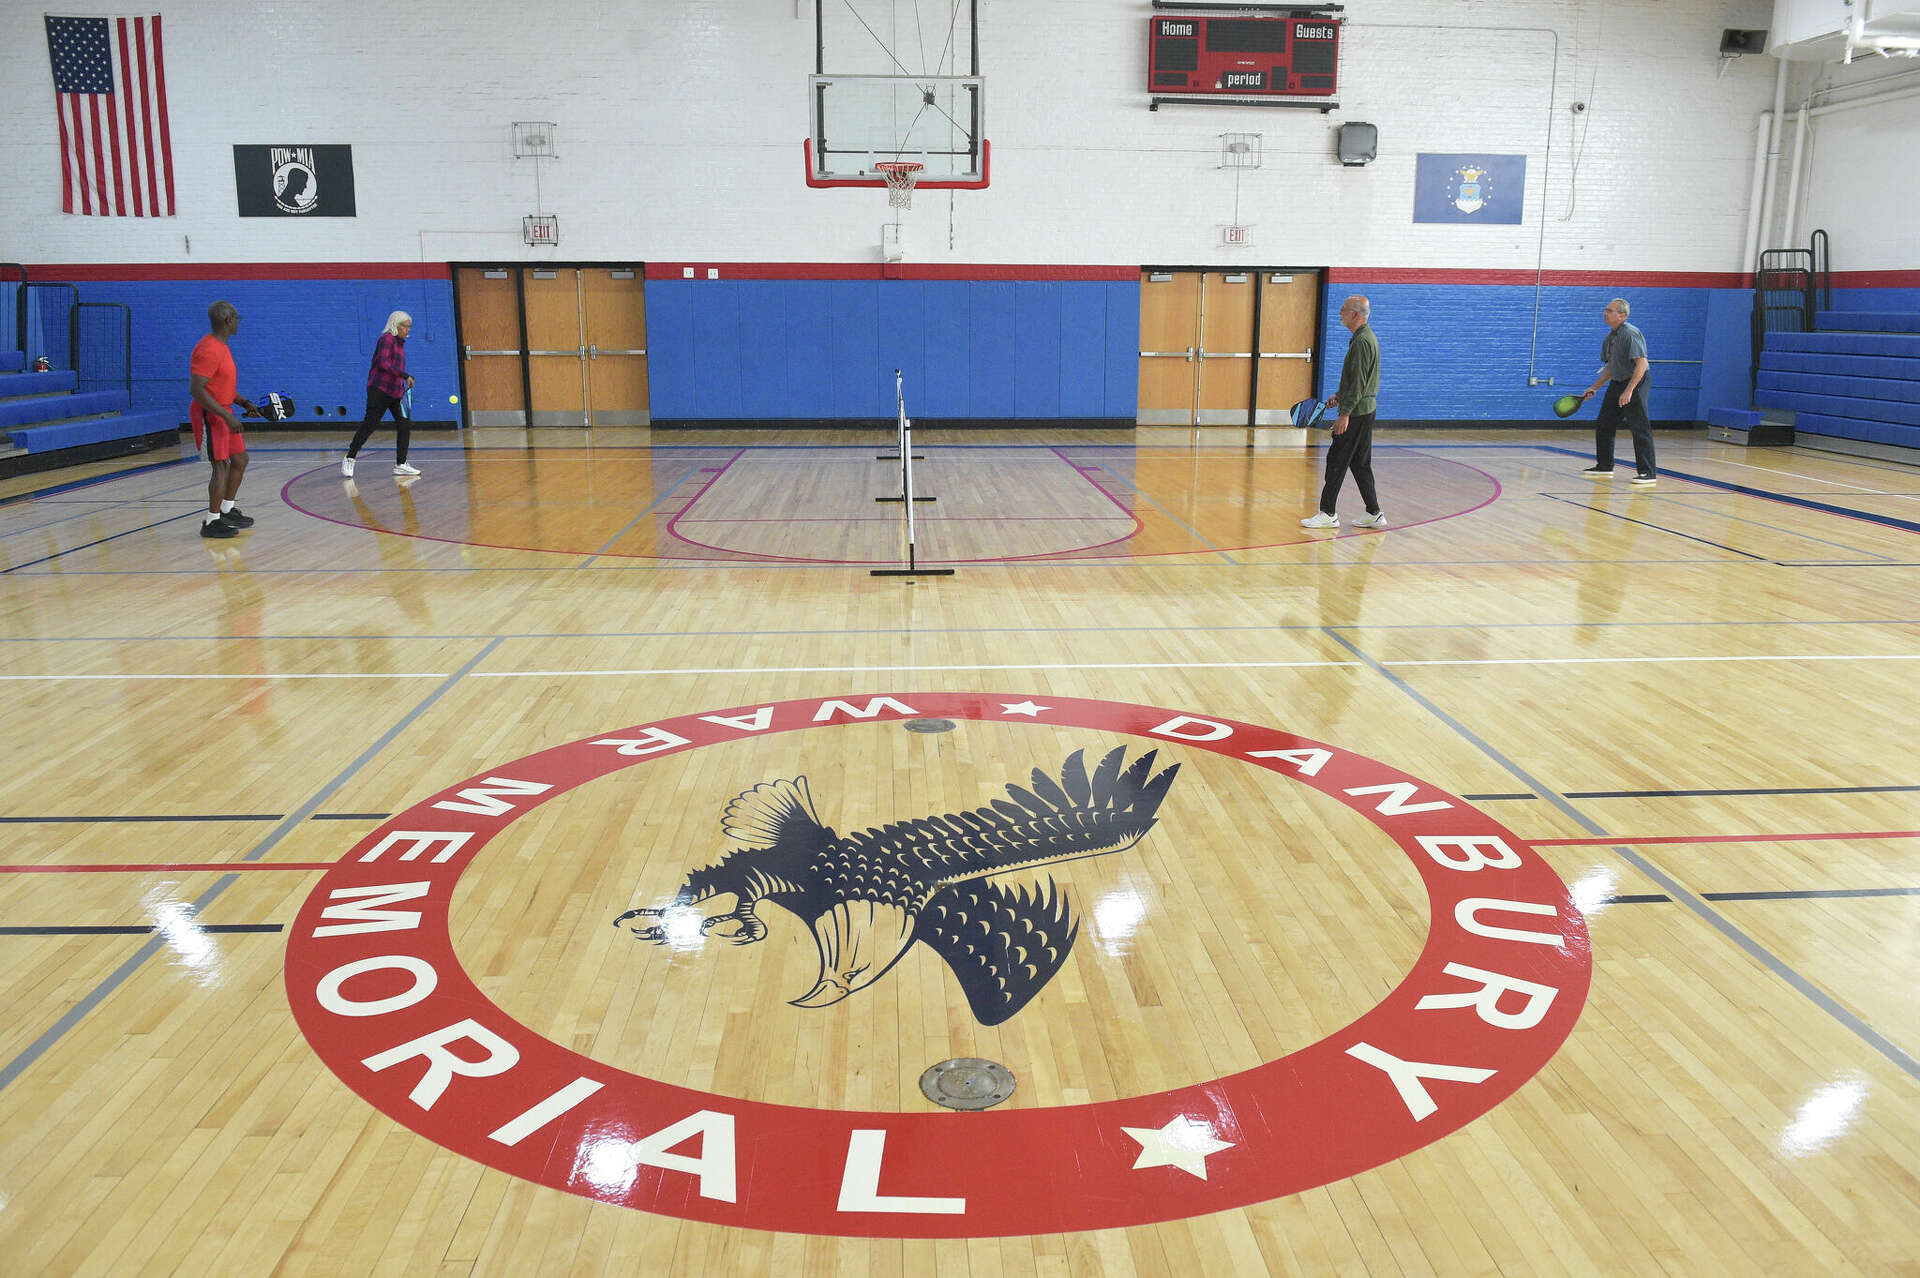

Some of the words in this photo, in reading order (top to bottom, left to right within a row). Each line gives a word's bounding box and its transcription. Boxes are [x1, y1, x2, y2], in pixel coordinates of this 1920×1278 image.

[1162, 21, 1193, 36] Home
[1296, 24, 1333, 39] Guests
[1227, 72, 1261, 88] period
[271, 147, 291, 175] POW
[296, 147, 316, 175] MIA
[533, 225, 550, 238] EXIT
[1229, 229, 1246, 241] EXIT
[586, 696, 921, 756] WAR
[1149, 715, 1559, 1122] DANBURY
[312, 777, 967, 1215] MEMORIAL
